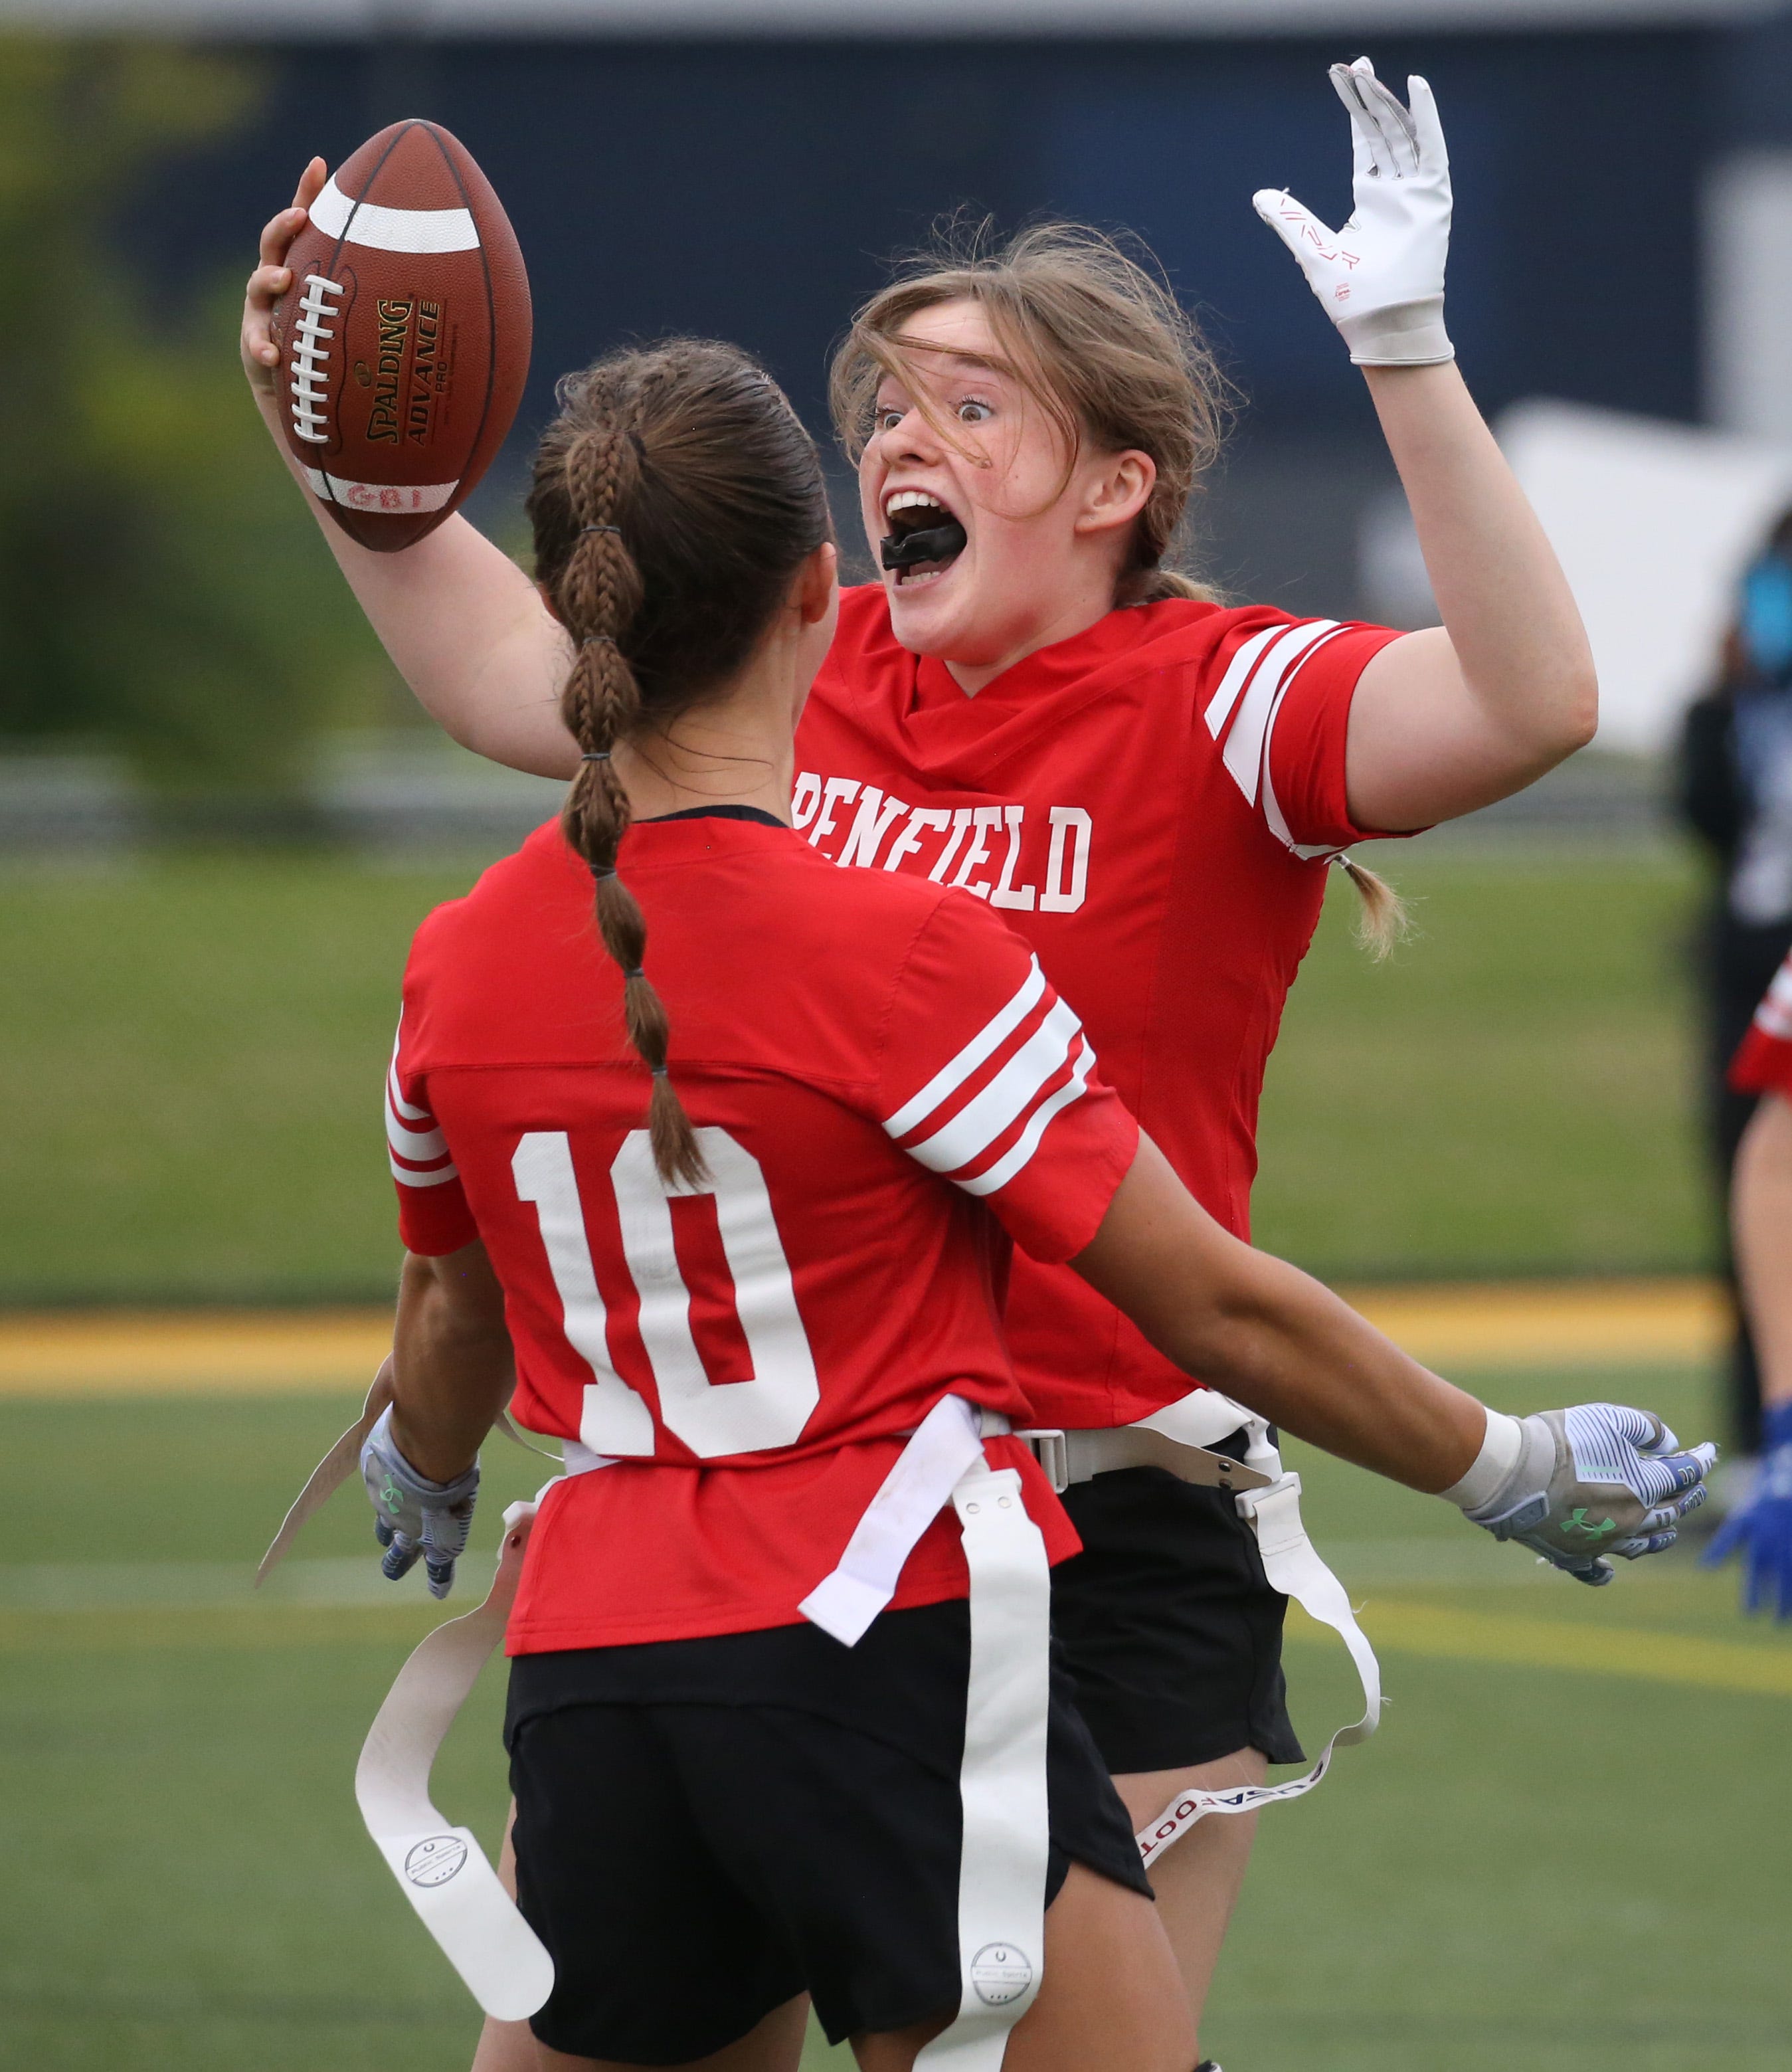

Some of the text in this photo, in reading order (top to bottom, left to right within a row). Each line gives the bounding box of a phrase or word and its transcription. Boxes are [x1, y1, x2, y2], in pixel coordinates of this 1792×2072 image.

[366, 300, 413, 444] SPALDING
[408, 300, 440, 447] ADVANCE
[435, 361, 448, 393] PRO
[790, 771, 1093, 913] PENFIELD
[511, 1126, 820, 1459] 10
